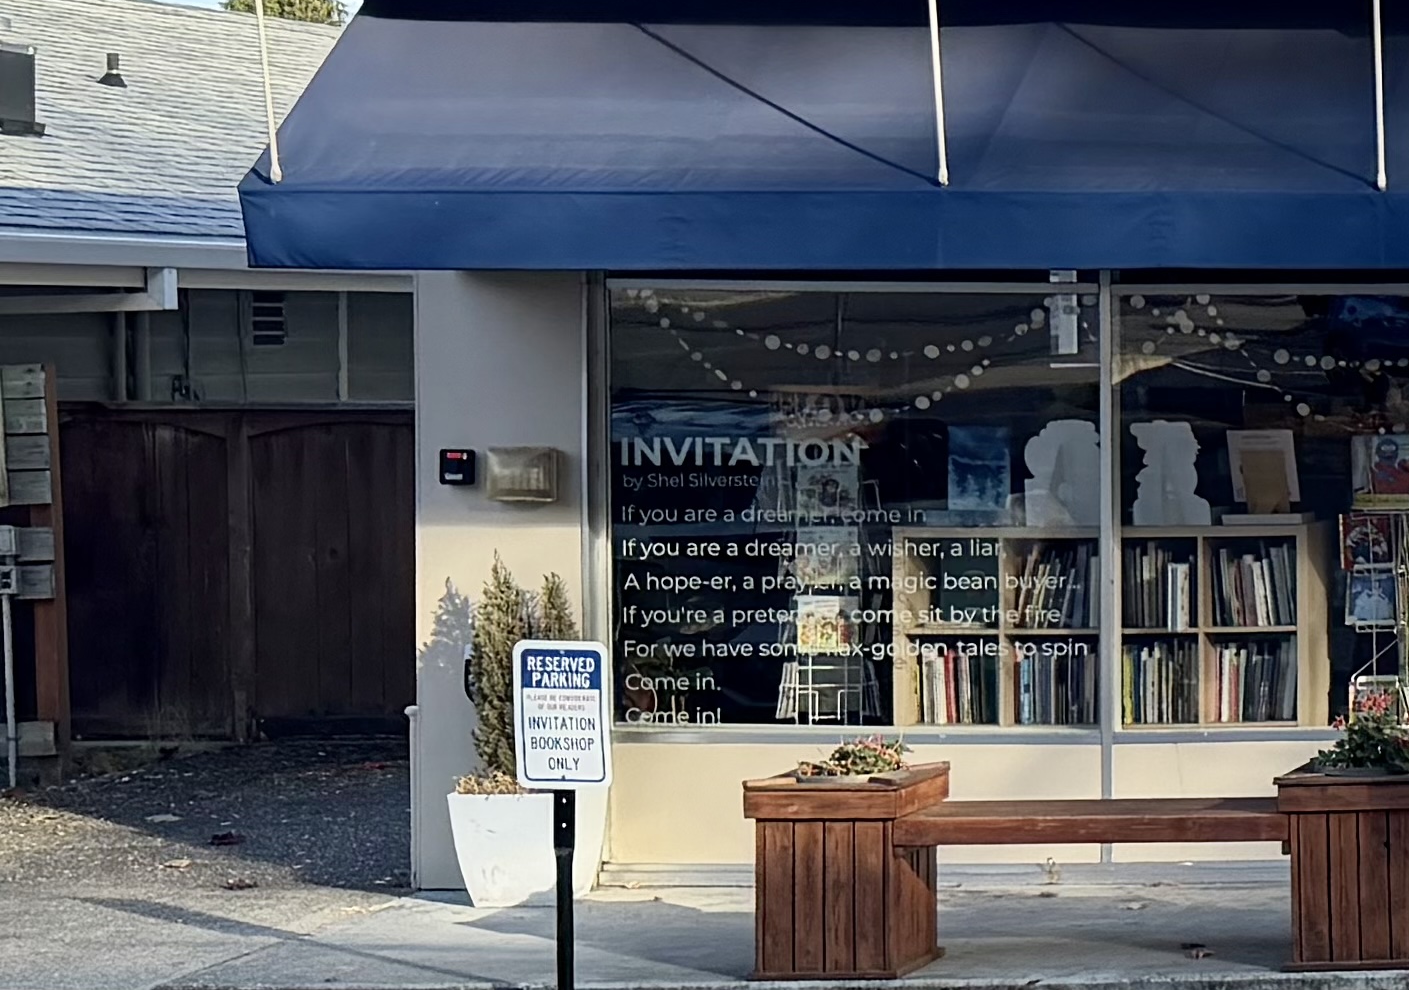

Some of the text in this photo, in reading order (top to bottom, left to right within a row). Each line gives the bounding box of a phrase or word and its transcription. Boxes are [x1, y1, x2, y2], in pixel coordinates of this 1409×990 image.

[620, 436, 861, 467] INVITATION
[623, 474, 643, 491] by
[647, 473, 684, 487] Shel
[621, 505, 636, 522] If
[639, 509, 678, 526] you
[684, 508, 718, 522] are
[723, 508, 735, 522] a
[840, 508, 901, 522] come
[908, 506, 927, 522] in
[622, 539, 636, 556] If
[640, 542, 680, 560] you
[686, 542, 721, 556] are
[726, 542, 739, 556] a
[745, 538, 843, 559] dreamer,
[849, 541, 862, 556] a
[868, 538, 945, 559] wisher,
[950, 541, 963, 556] a
[623, 573, 641, 590] A
[646, 572, 737, 594] hope-er,
[742, 575, 755, 590] a
[849, 575, 862, 590] a
[868, 571, 937, 594] magic
[943, 571, 998, 590] bean
[622, 605, 637, 623] If
[641, 606, 708, 628] you're
[712, 609, 725, 623] a
[851, 609, 914, 623] come
[918, 605, 942, 623] sit
[950, 605, 977, 627] by
[983, 605, 1019, 623] the
[1025, 604, 1062, 623] fire
[624, 640, 658, 657] For
[663, 642, 696, 657] we
[702, 639, 753, 657] have
[957, 638, 1009, 656] tales
[1015, 639, 1037, 656] to
[1042, 638, 1088, 660] spin
[526, 656, 596, 672] RESERVED
[532, 671, 591, 688] PARKING
[625, 672, 721, 691] Come in.
[528, 716, 596, 731] INVITATION
[625, 707, 722, 724] Come in!
[530, 736, 595, 751] BOOKSHOP
[548, 756, 580, 771] ONLY
